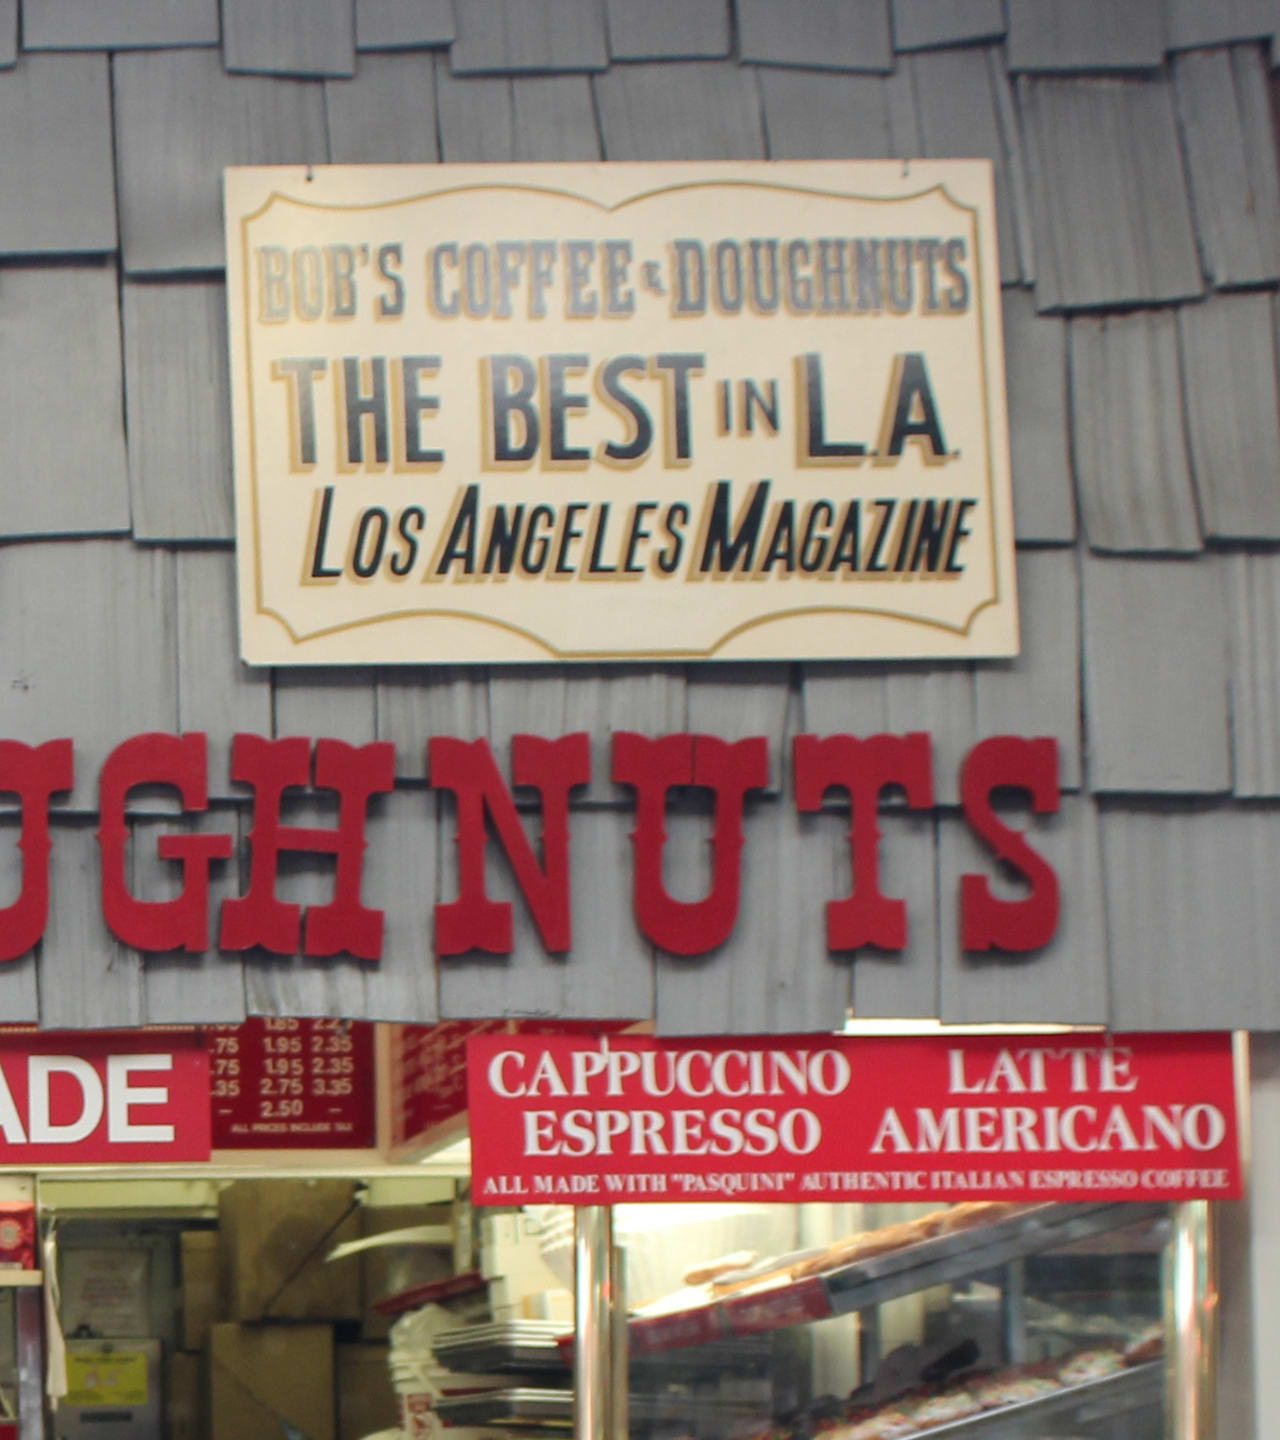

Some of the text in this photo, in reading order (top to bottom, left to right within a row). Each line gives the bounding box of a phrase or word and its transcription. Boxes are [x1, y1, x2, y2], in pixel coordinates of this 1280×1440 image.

[258, 237, 970, 323] BOB'S COFFEE & DOUGHNUTS
[272, 356, 445, 473] THE
[480, 353, 707, 472] BEST
[715, 377, 780, 438] IN
[300, 480, 978, 586] LOS ANGELES MAGAZINE
[263, 1037, 303, 1053] 1.95
[264, 1058, 304, 1075] 1.95
[312, 1057, 354, 1074] 2.35
[487, 1049, 852, 1099] CAPPUCCINO
[948, 1047, 1137, 1096] LATTE
[260, 1079, 303, 1096] 2.75
[313, 1078, 352, 1096] 3.35
[260, 1100, 303, 1118] 2.50
[522, 1103, 1227, 1158] ESPRESSO AMERICANO
[483, 1175, 529, 1194] ALL
[533, 1174, 600, 1194] MADE
[604, 1173, 667, 1193] WITH
[799, 1171, 928, 1192] AUTHENTIC
[930, 1169, 1025, 1190] ITALIAN
[1029, 1168, 1139, 1190] ESPRESSO
[1141, 1168, 1230, 1189] COFFEE
